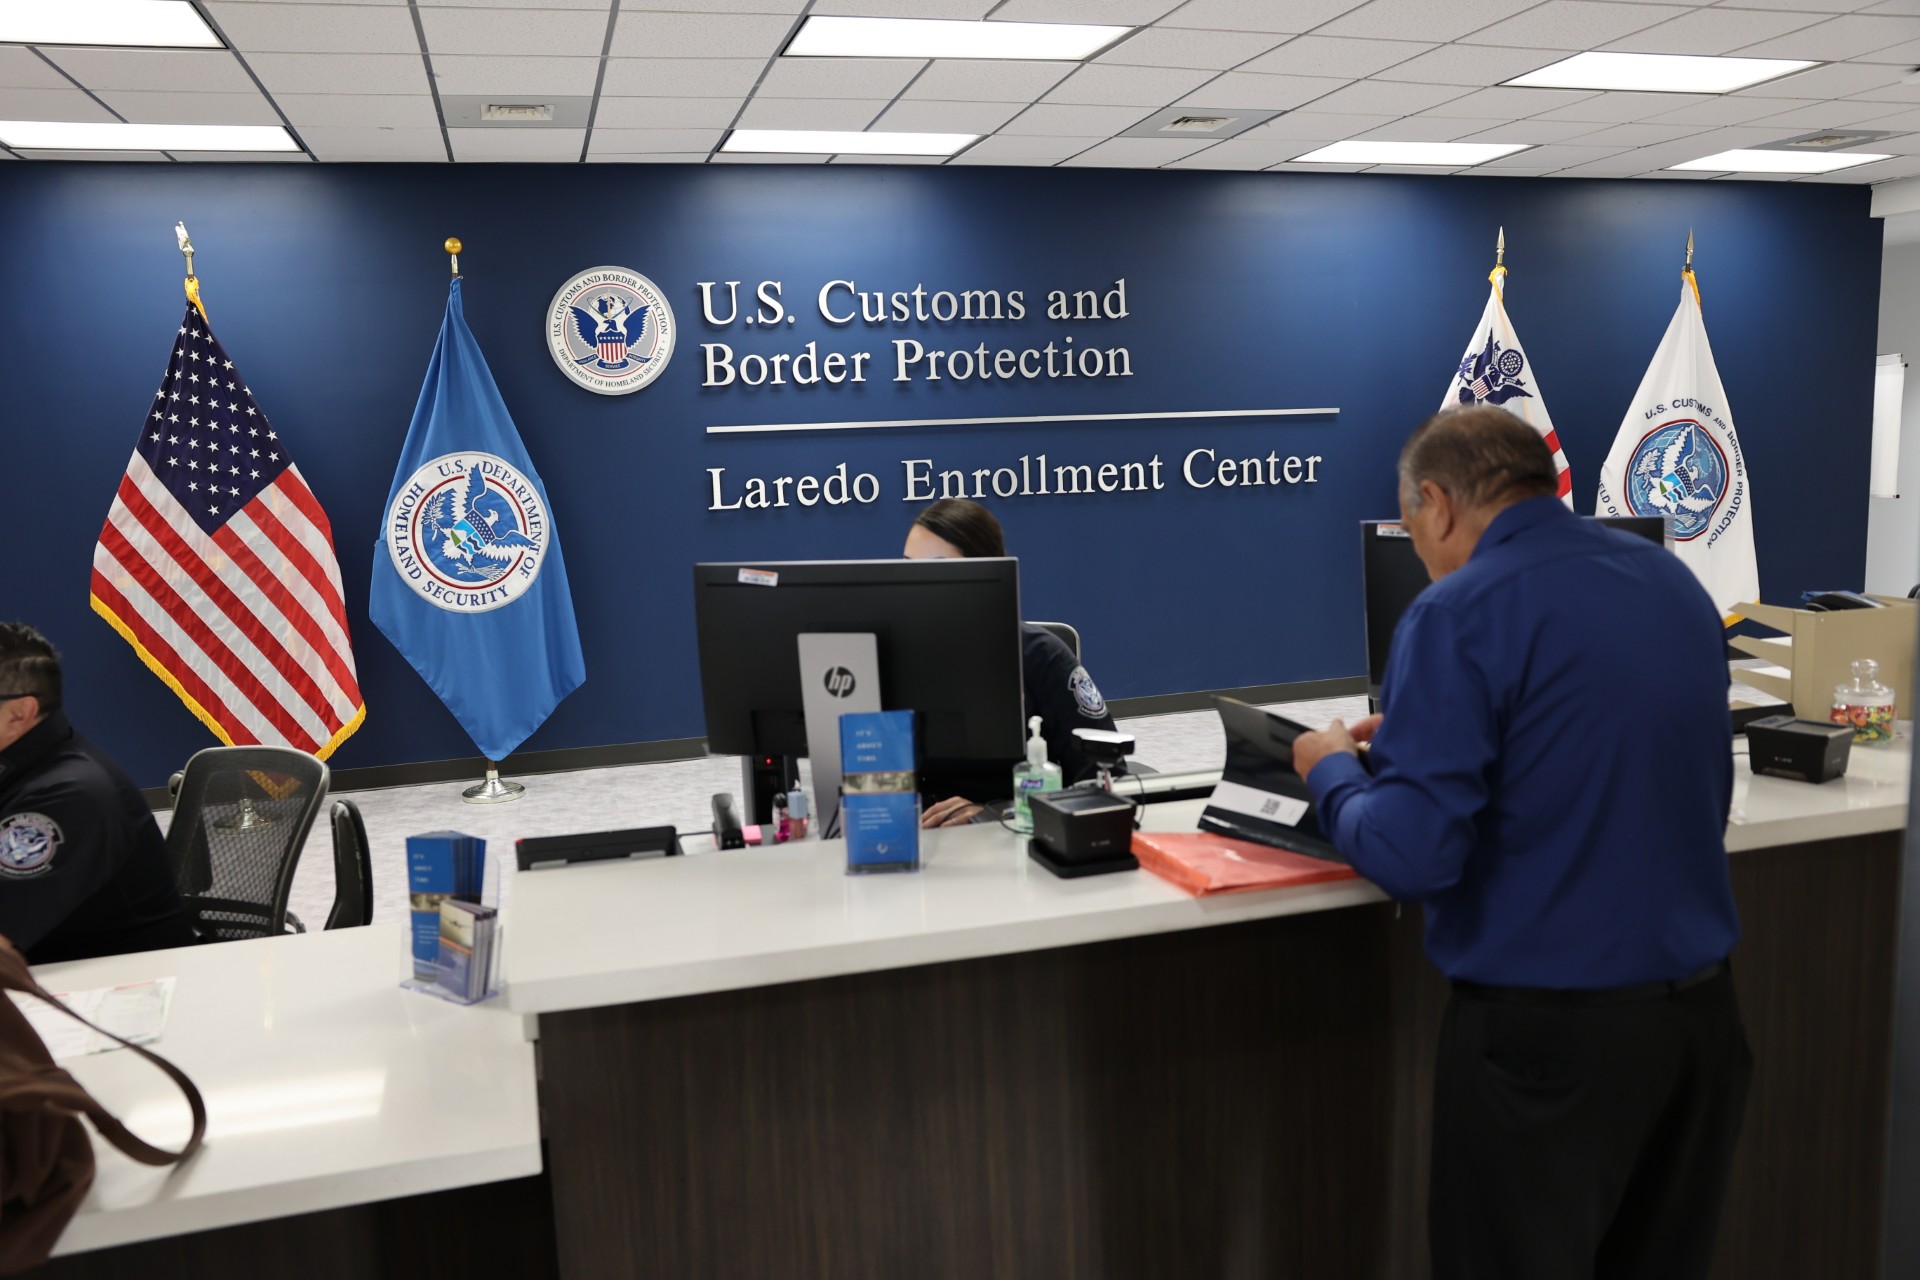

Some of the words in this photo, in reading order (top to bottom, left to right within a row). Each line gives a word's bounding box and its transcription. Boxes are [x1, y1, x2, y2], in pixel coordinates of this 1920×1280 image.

[583, 275, 601, 287] AND
[602, 273, 637, 289] BORDER
[555, 281, 582, 321] CUSTOMS
[638, 284, 668, 335] PROTECTION
[697, 280, 795, 325] U.S.
[818, 279, 1026, 323] Customs
[1047, 278, 1129, 320] and
[554, 321, 562, 337] U.S.
[559, 348, 594, 383] DEPARTMENT
[594, 379, 604, 387] OF
[605, 373, 644, 388] HOMELAND
[644, 346, 665, 376] SECURITY
[700, 341, 871, 386] Border
[892, 336, 1133, 382] Protection
[1645, 404, 1668, 420] U.S.
[1713, 417, 1727, 431] AND
[437, 459, 467, 477] U.S.
[707, 462, 880, 510] Laredo
[902, 454, 1164, 502] Enrollment
[1183, 448, 1322, 488] Center
[482, 460, 543, 555] DEPARTMENT
[1706, 481, 1744, 549] PROTECTION
[394, 481, 425, 580] HOMELAND
[519, 556, 536, 579] OF
[422, 580, 509, 606] SECURITY
[825, 666, 855, 698] hp
